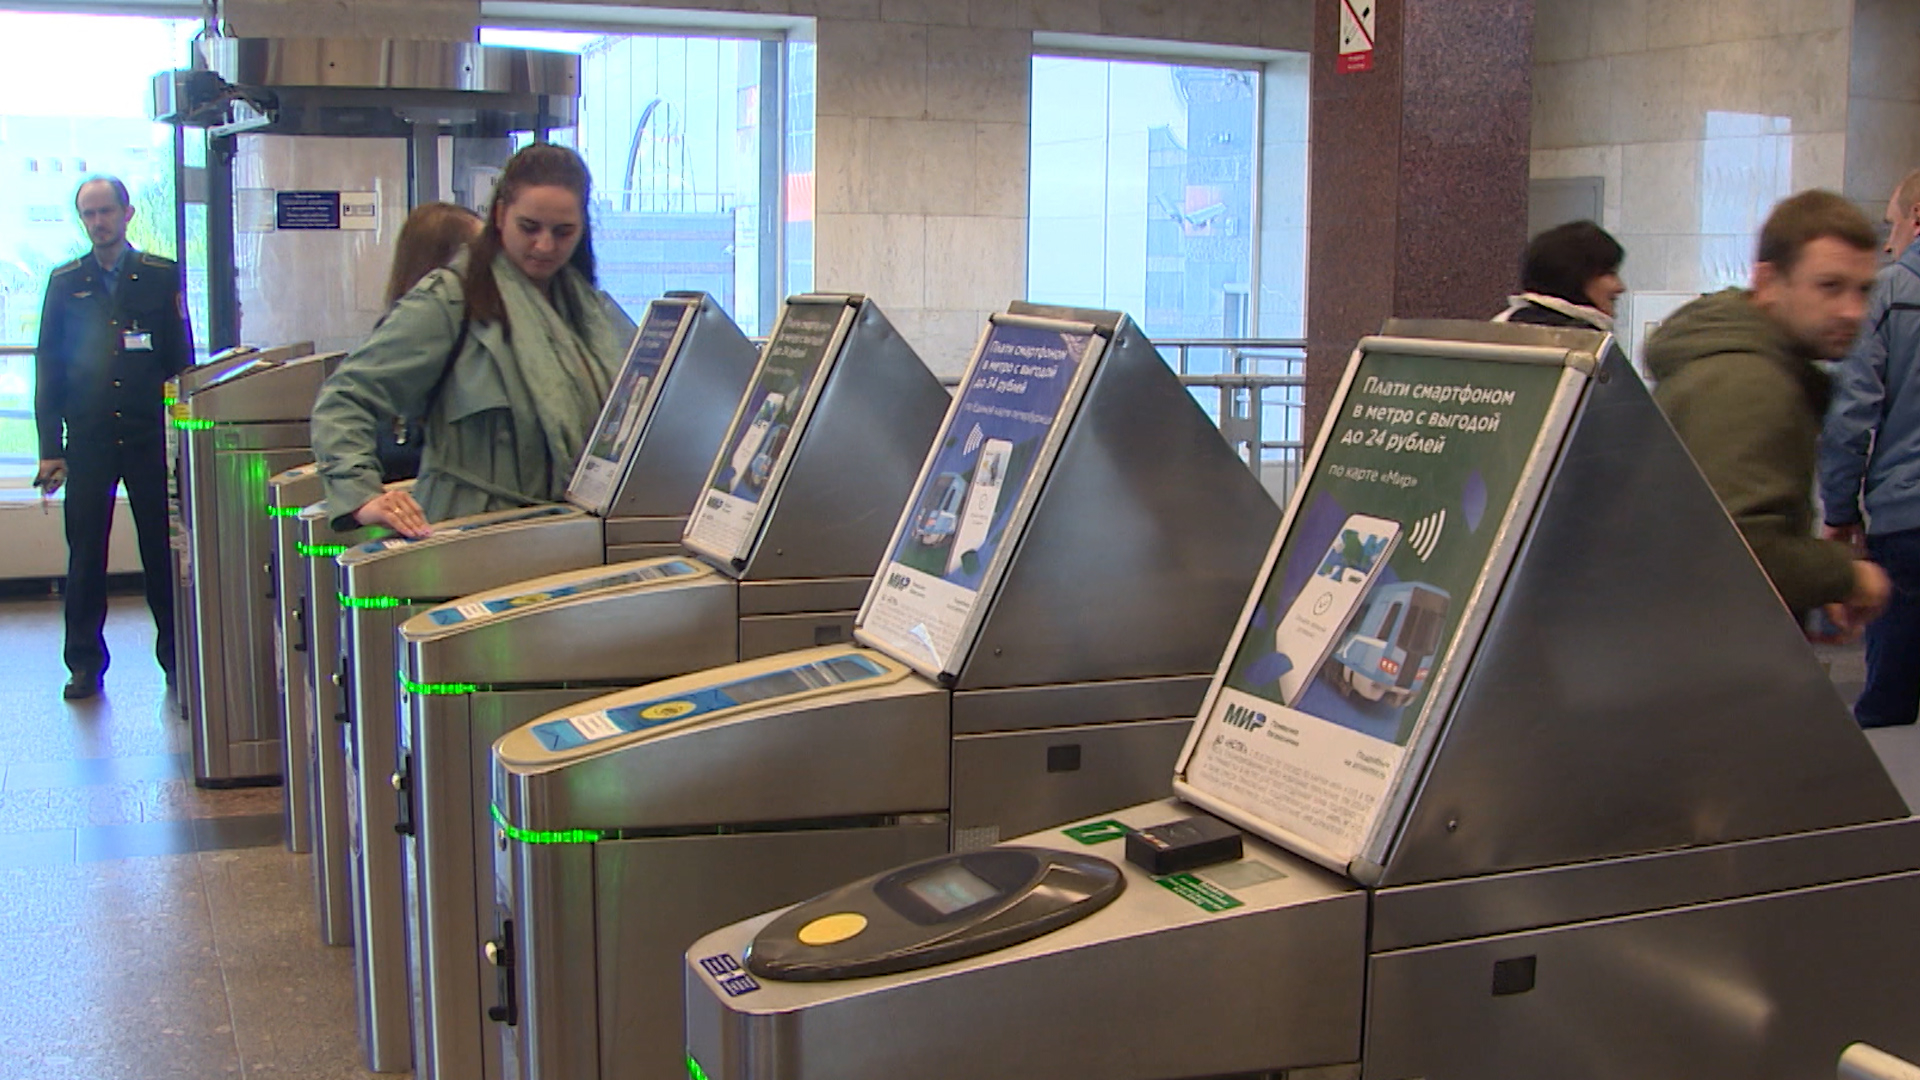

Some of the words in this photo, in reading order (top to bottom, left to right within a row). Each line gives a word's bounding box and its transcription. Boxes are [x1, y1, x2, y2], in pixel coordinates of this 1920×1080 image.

[1363, 376, 1410, 397] Плати
[1412, 382, 1516, 406] смартфоном
[1352, 404, 1362, 418] в
[1365, 405, 1413, 427] метро
[1415, 411, 1426, 425] с
[1428, 411, 1502, 434] выгодой
[1340, 429, 1364, 446] до
[1365, 428, 1387, 447] 24
[1385, 431, 1447, 454] рублей
[1328, 463, 1343, 479] по
[1344, 467, 1379, 483] карте
[1380, 469, 1418, 489] «Мир»
[1222, 703, 1267, 733] МИР
